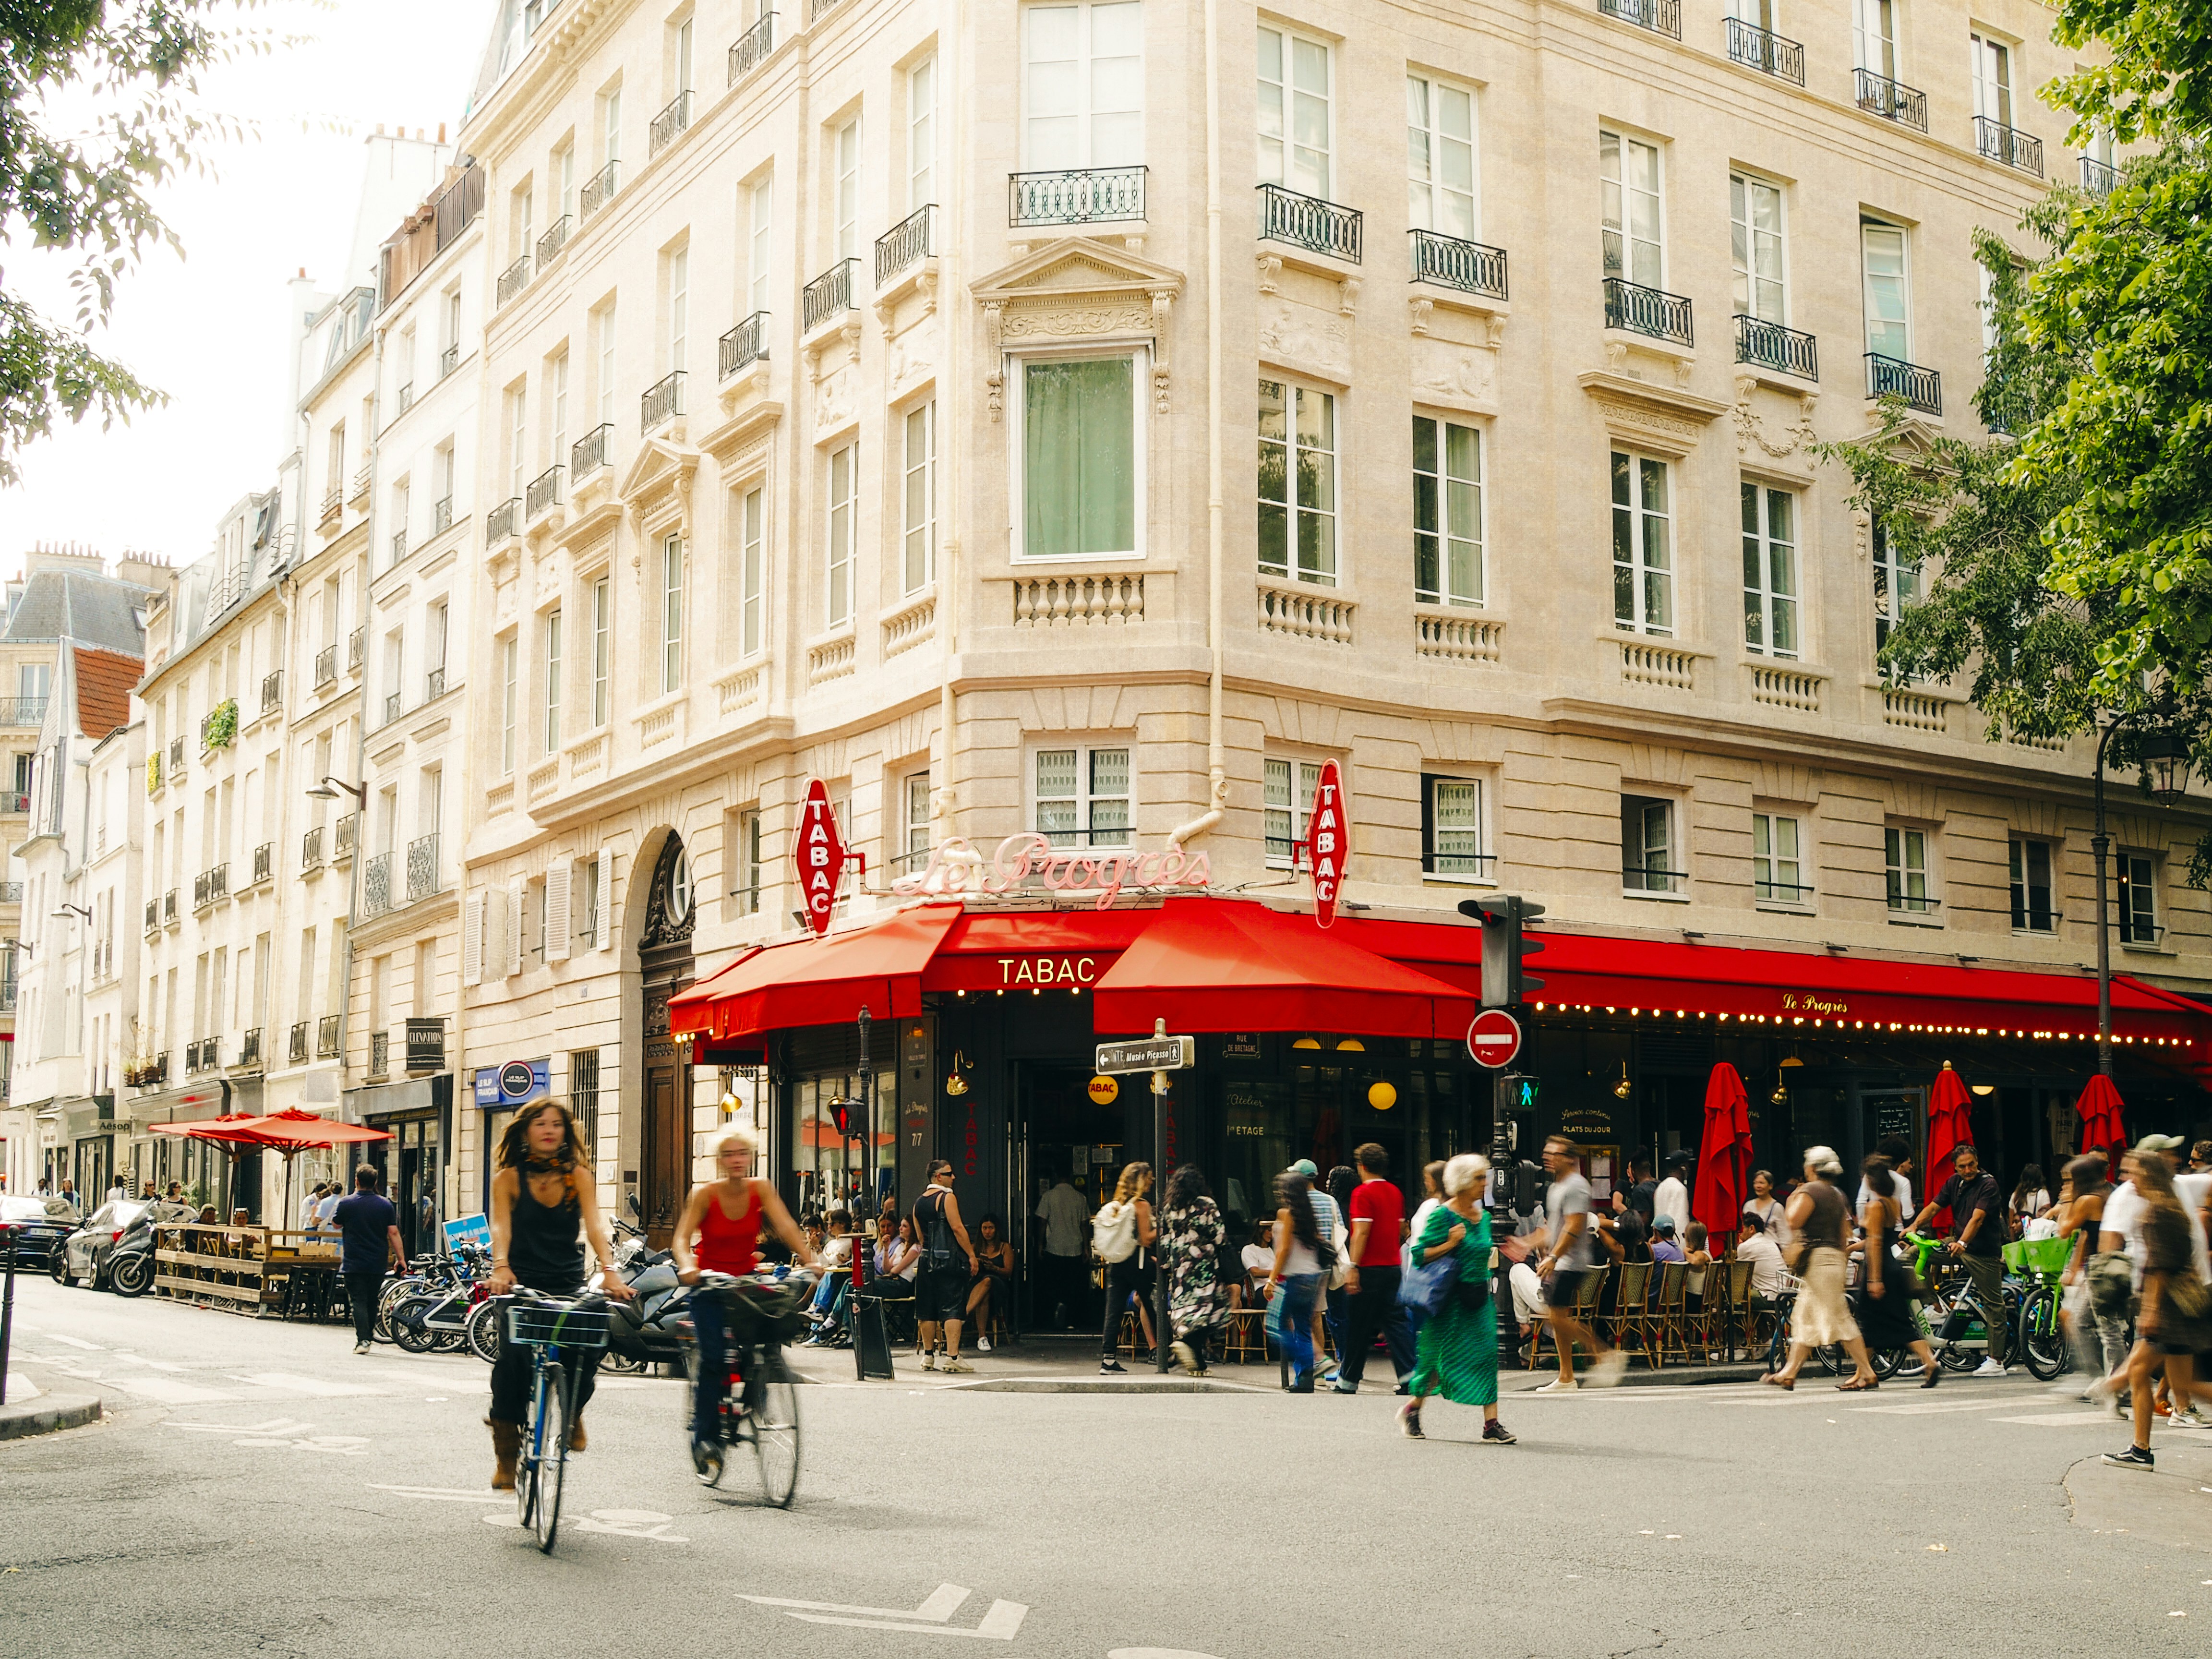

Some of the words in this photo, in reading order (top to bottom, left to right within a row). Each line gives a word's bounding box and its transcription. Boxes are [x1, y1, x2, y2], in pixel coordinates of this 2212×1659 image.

[808, 800, 831, 914] TABAC
[1317, 785, 1336, 902] TABAC
[894, 837, 970, 896] Le
[982, 832, 1213, 912] Progrès
[998, 957, 1095, 984] TABAC
[1781, 993, 1798, 1010] Le
[1802, 994, 1847, 1015] Progrès
[409, 1032, 442, 1042] ELEVATION
[1234, 1044, 1256, 1052] BRETAGNE
[1126, 1051, 1145, 1062] Musée
[1146, 1050, 1169, 1060] Picasso
[478, 1079, 483, 1087] LE
[965, 1103, 977, 1175] TABAC
[1916, 1309, 1931, 1336] Lime
